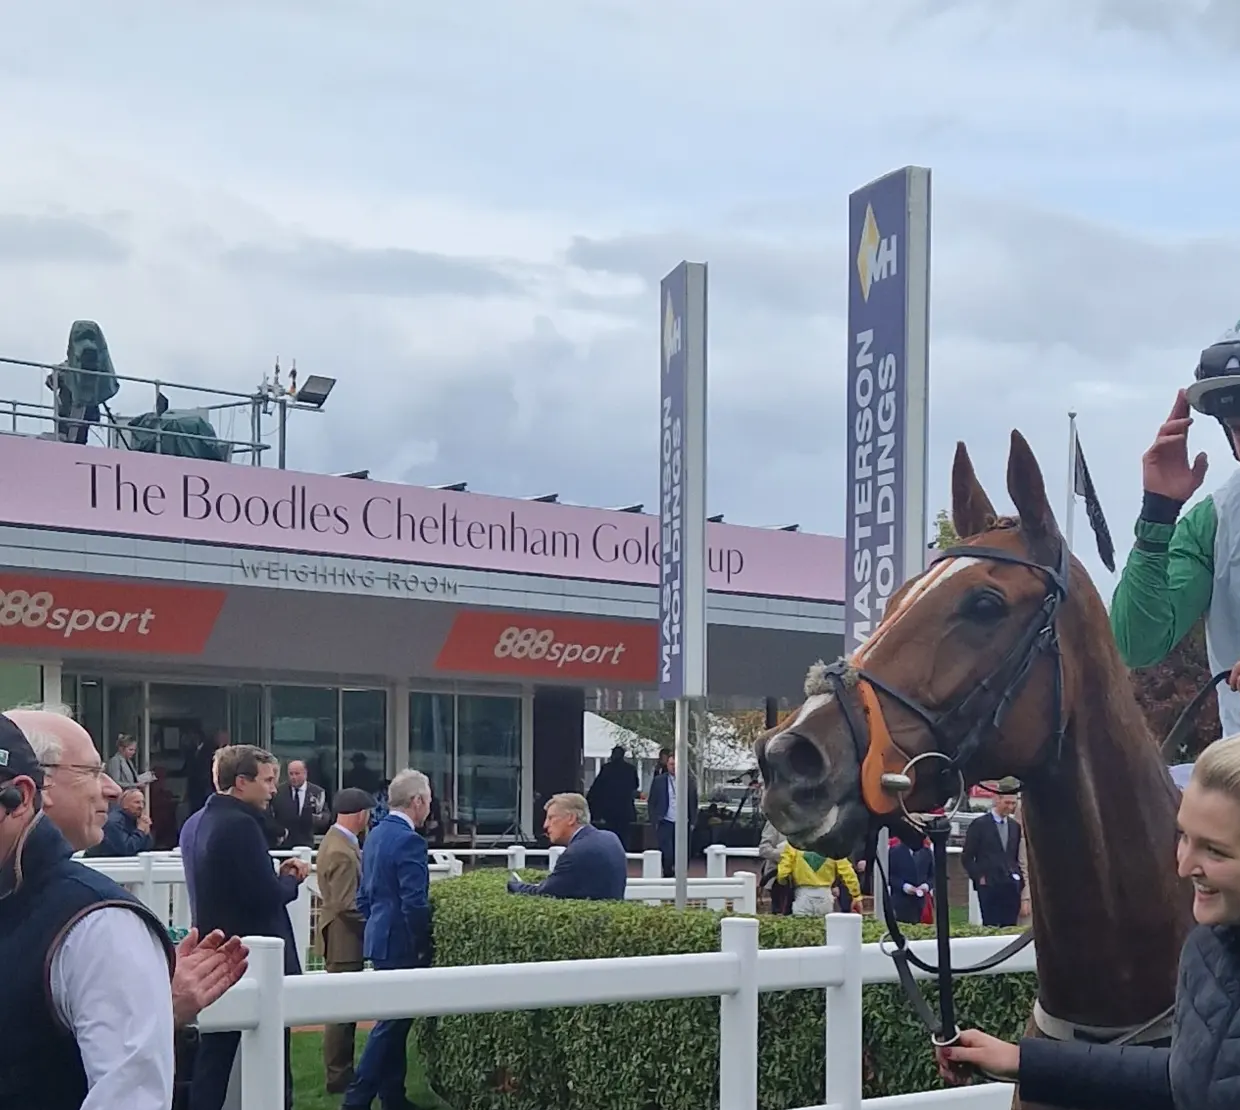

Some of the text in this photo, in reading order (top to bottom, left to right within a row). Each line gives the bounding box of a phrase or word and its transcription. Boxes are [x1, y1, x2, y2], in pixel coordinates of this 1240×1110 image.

[75, 461, 167, 516] The
[183, 474, 350, 535] Boodles
[362, 496, 580, 560] Cheltenham
[708, 546, 745, 585] up
[239, 558, 458, 596] WEIGHING ROOM
[662, 396, 672, 683] MASTERSON
[671, 416, 681, 656] HOLDINGS
[493, 625, 626, 668] 888sport
